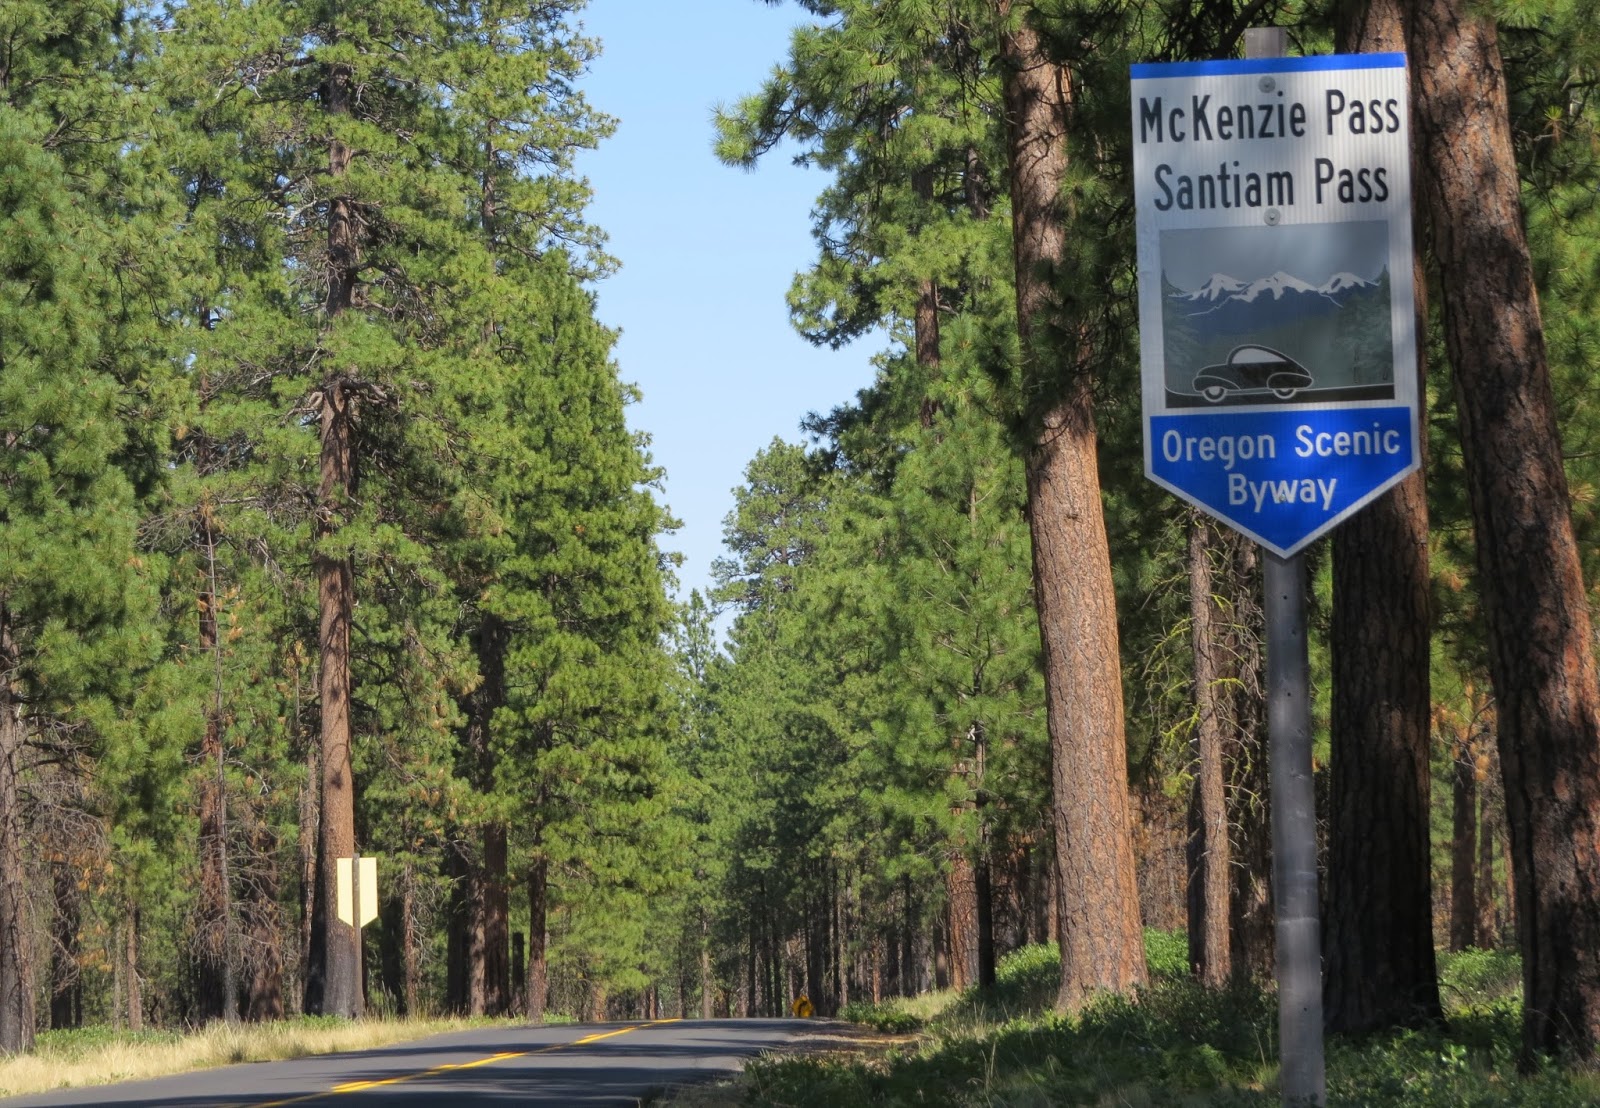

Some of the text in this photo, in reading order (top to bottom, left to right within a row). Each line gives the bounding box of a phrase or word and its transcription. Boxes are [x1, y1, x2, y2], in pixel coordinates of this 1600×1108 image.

[1139, 89, 1400, 143] McKenzie Pass
[1154, 158, 1389, 211] Santiam Pass
[1162, 422, 1400, 470] Oregon Scenic
[1228, 473, 1337, 513] Byway
